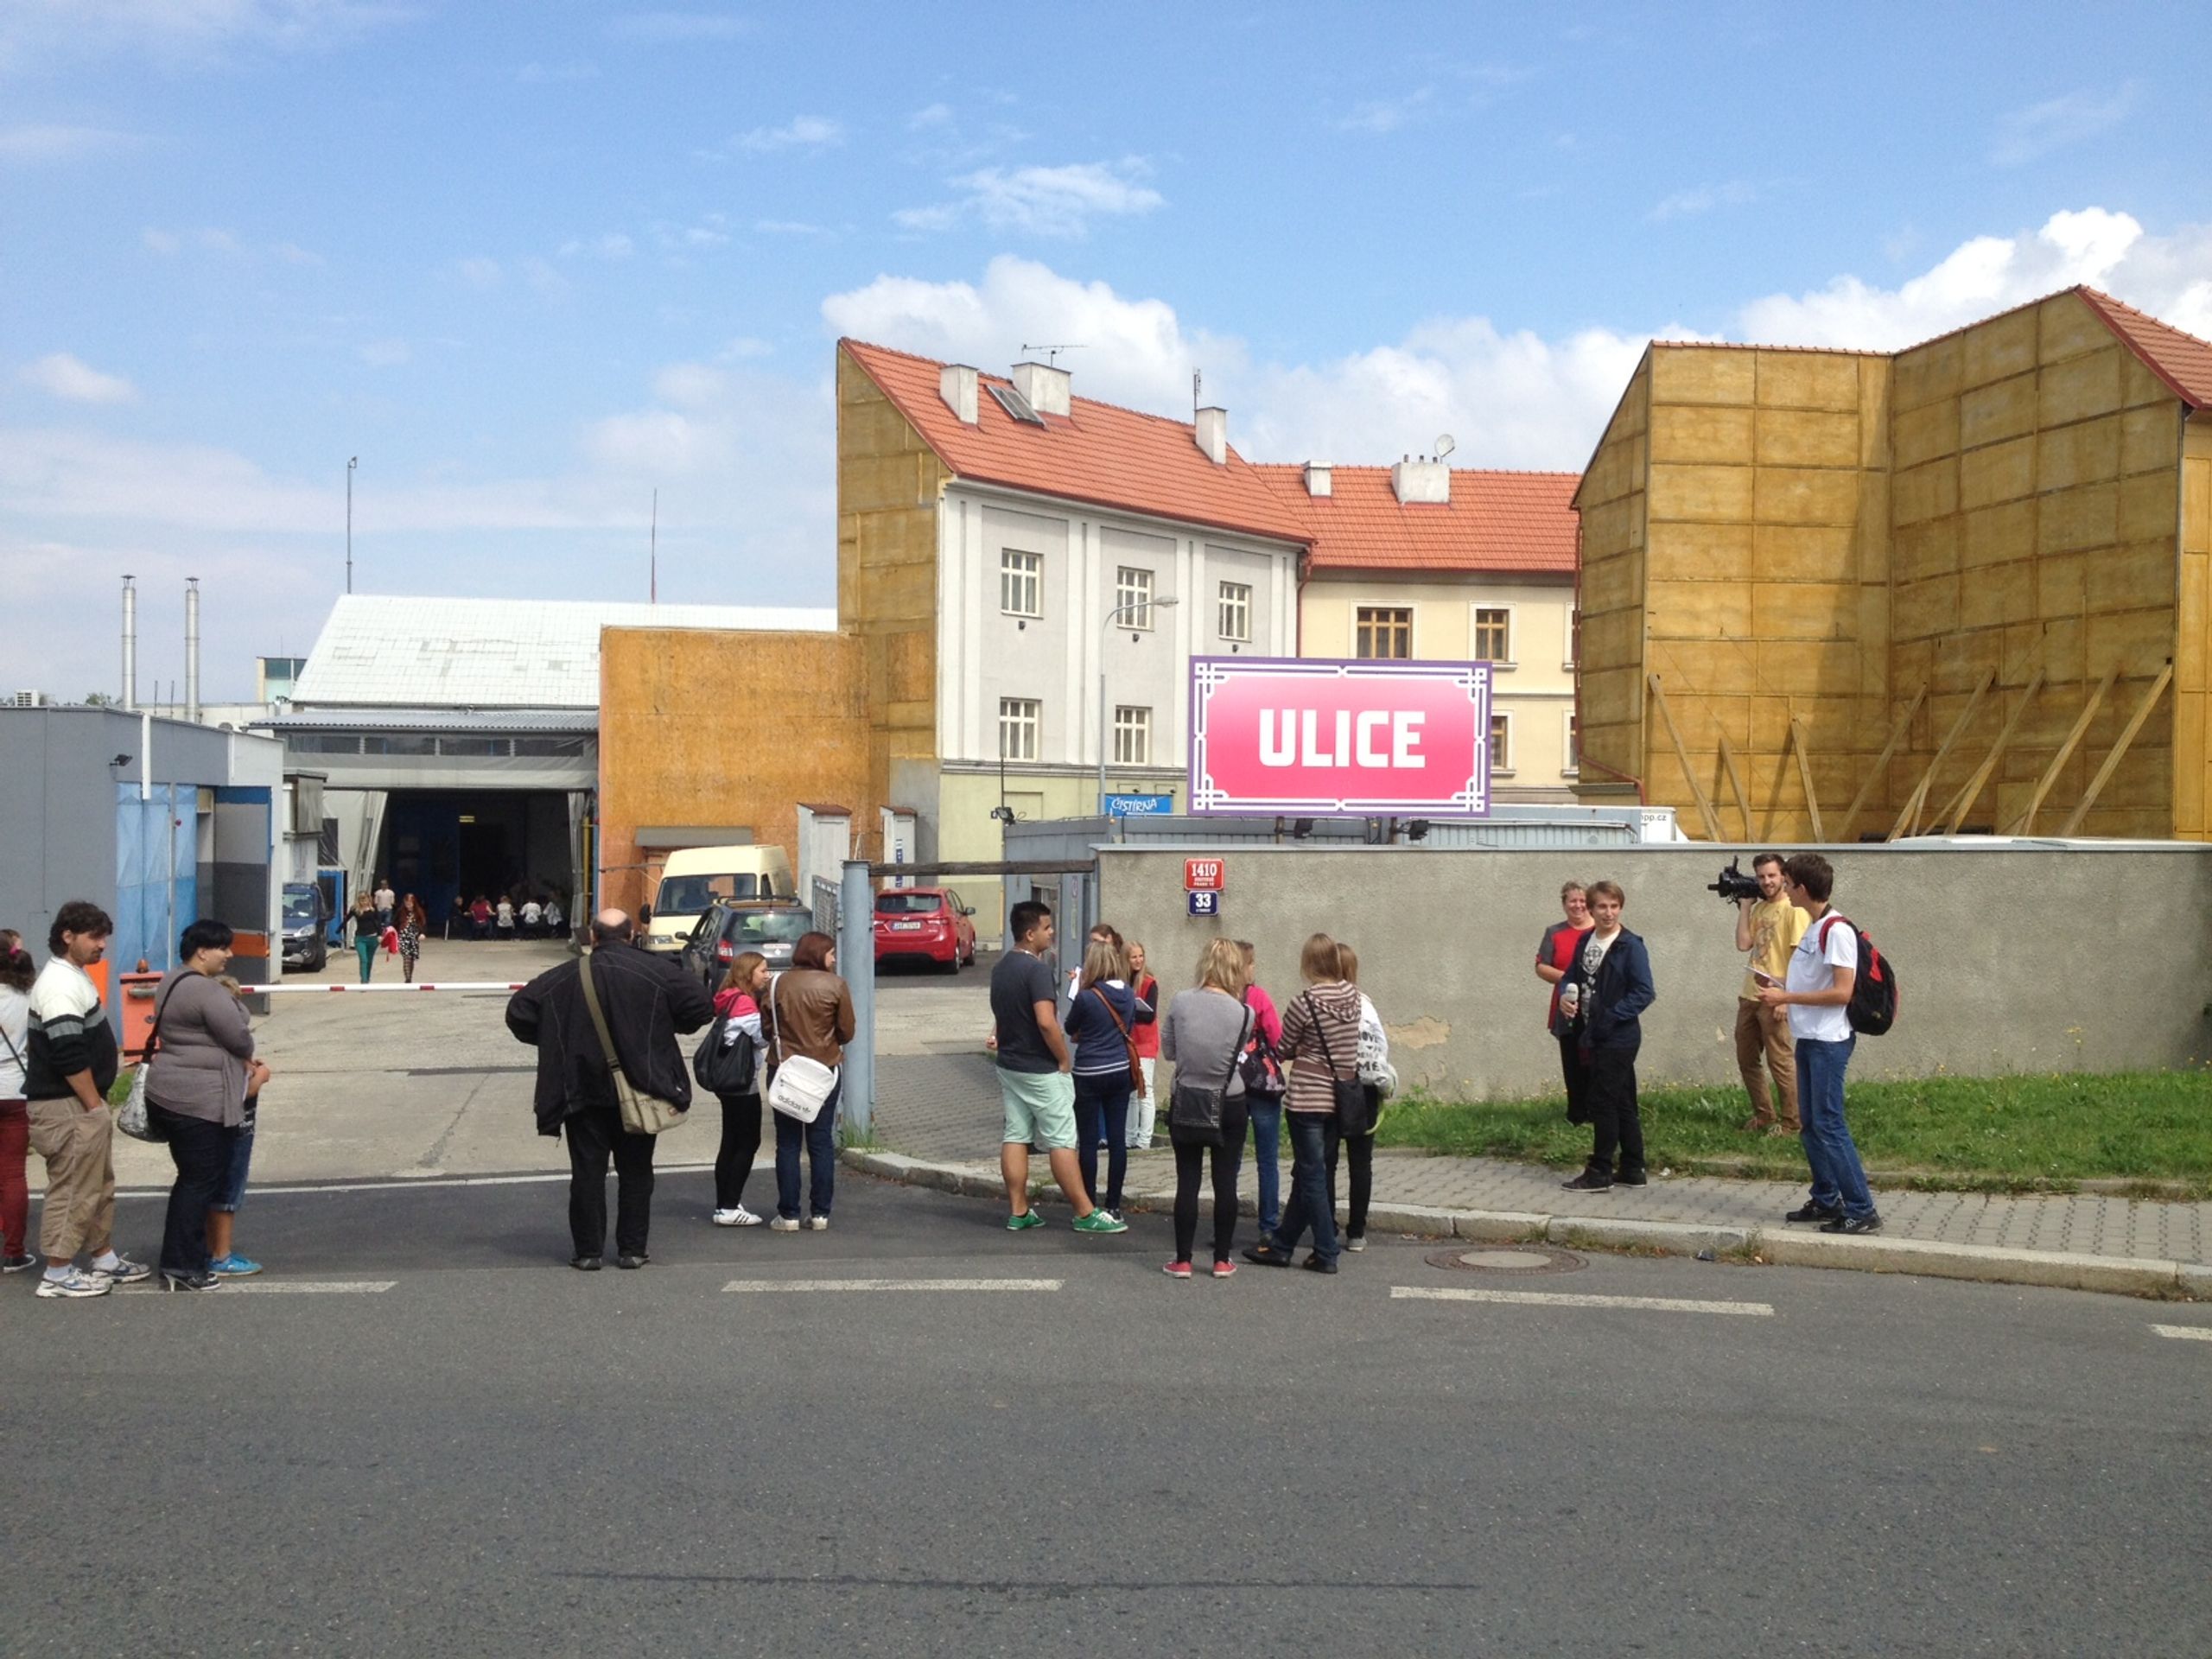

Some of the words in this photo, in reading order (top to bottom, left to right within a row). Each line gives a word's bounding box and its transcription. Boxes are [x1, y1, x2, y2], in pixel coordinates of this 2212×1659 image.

[1259, 709, 1426, 768] ULICE
[1111, 797, 1158, 812] ČISTÍRNA
[1192, 862, 1217, 877] 1410
[1195, 893, 1211, 908] 33
[778, 1095, 801, 1110] adidas
